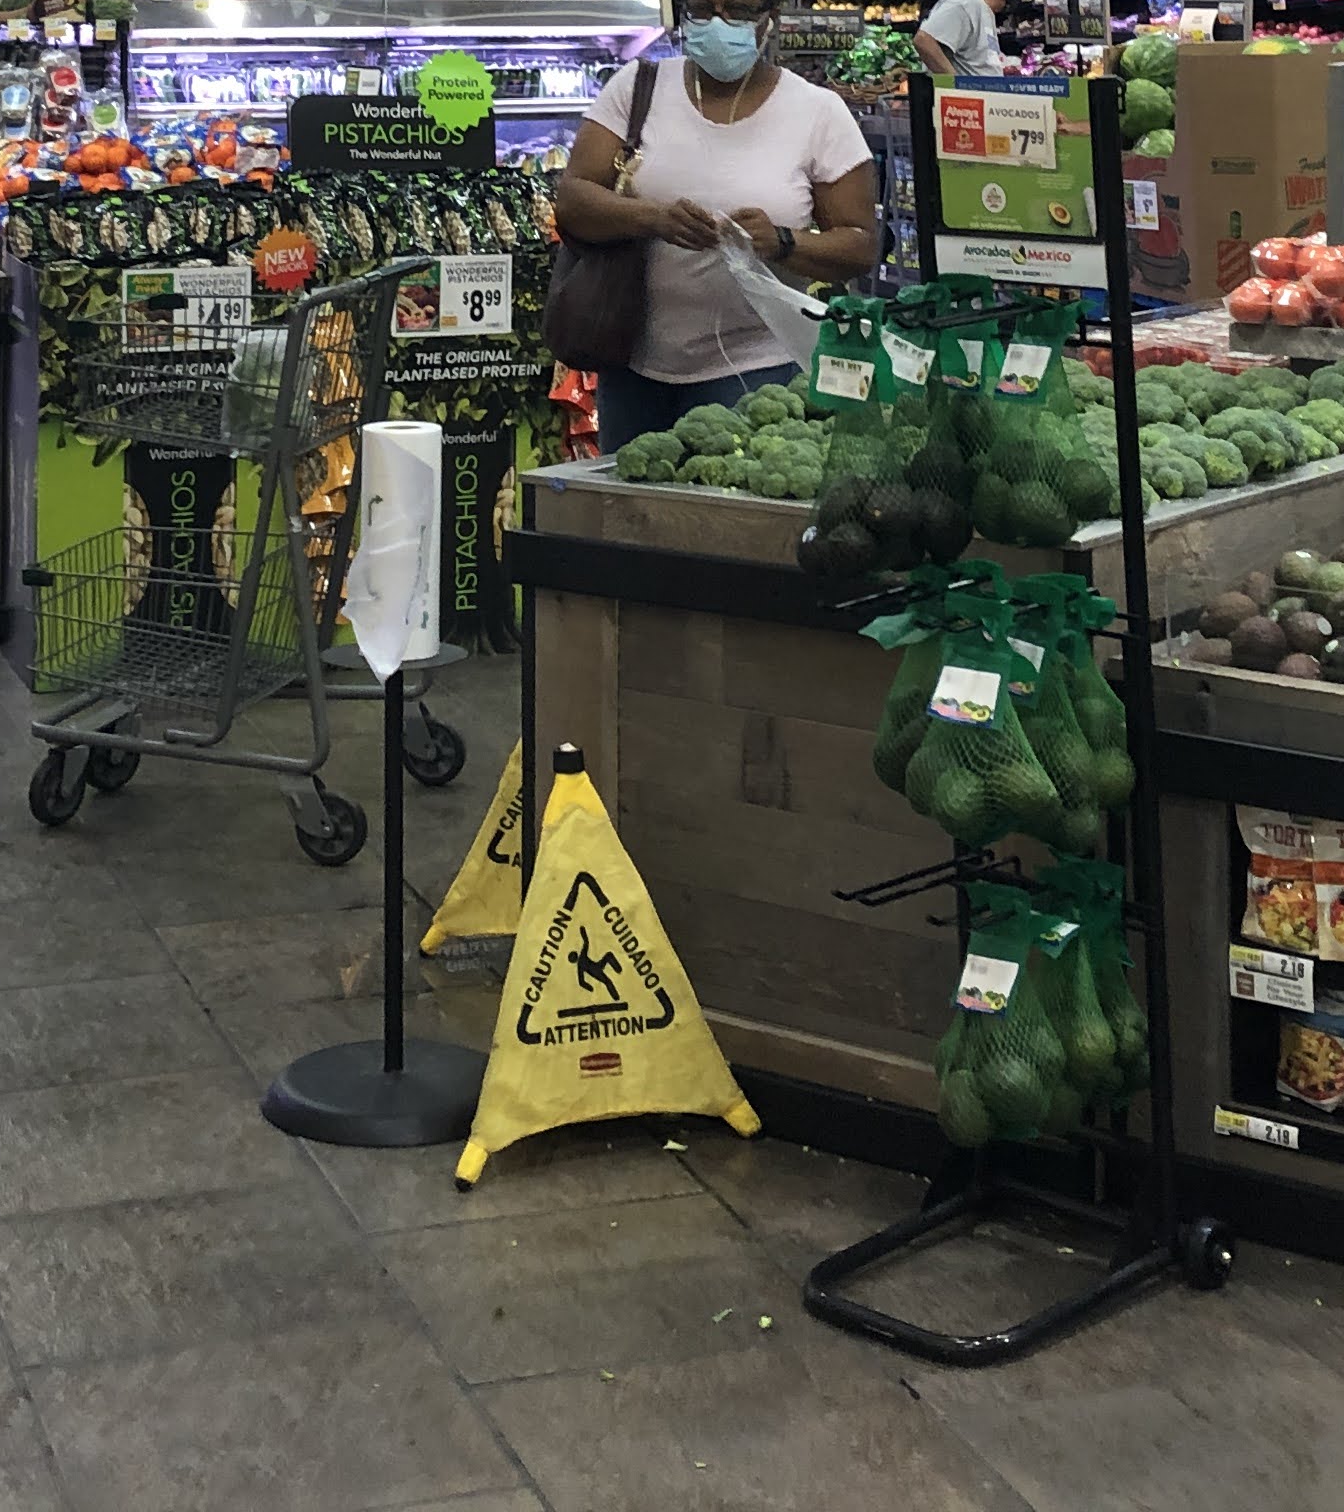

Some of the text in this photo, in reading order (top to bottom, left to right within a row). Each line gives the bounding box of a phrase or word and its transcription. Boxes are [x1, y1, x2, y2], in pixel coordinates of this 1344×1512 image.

[433, 76, 479, 87] Protein
[1038, 84, 1064, 94] READY
[428, 89, 485, 100] Powered
[946, 105, 980, 120] Always
[988, 107, 1040, 120] AVOCADOS
[943, 117, 959, 128] For
[325, 123, 465, 145] PISTACHIOS
[349, 148, 442, 160] The Wonderful Nut
[264, 247, 306, 266] NEW
[963, 244, 1012, 258] Avocados
[1027, 249, 1072, 263] Mexico
[265, 261, 309, 276] FLAVORS
[445, 266, 506, 276] WONDERFUL
[179, 278, 246, 288] WONDERFUL
[447, 275, 504, 284] PISTACHIOS
[415, 349, 513, 365] THE ORIGINAL
[385, 364, 542, 383] PLANT-BASED PROTEIN
[456, 454, 478, 611] PISTACHIOS
[171, 470, 196, 631] PISACHIOS
[604, 906, 661, 989] CUIDADO
[525, 911, 572, 1003] CAUTION
[544, 1016, 644, 1047] ATTENTION
